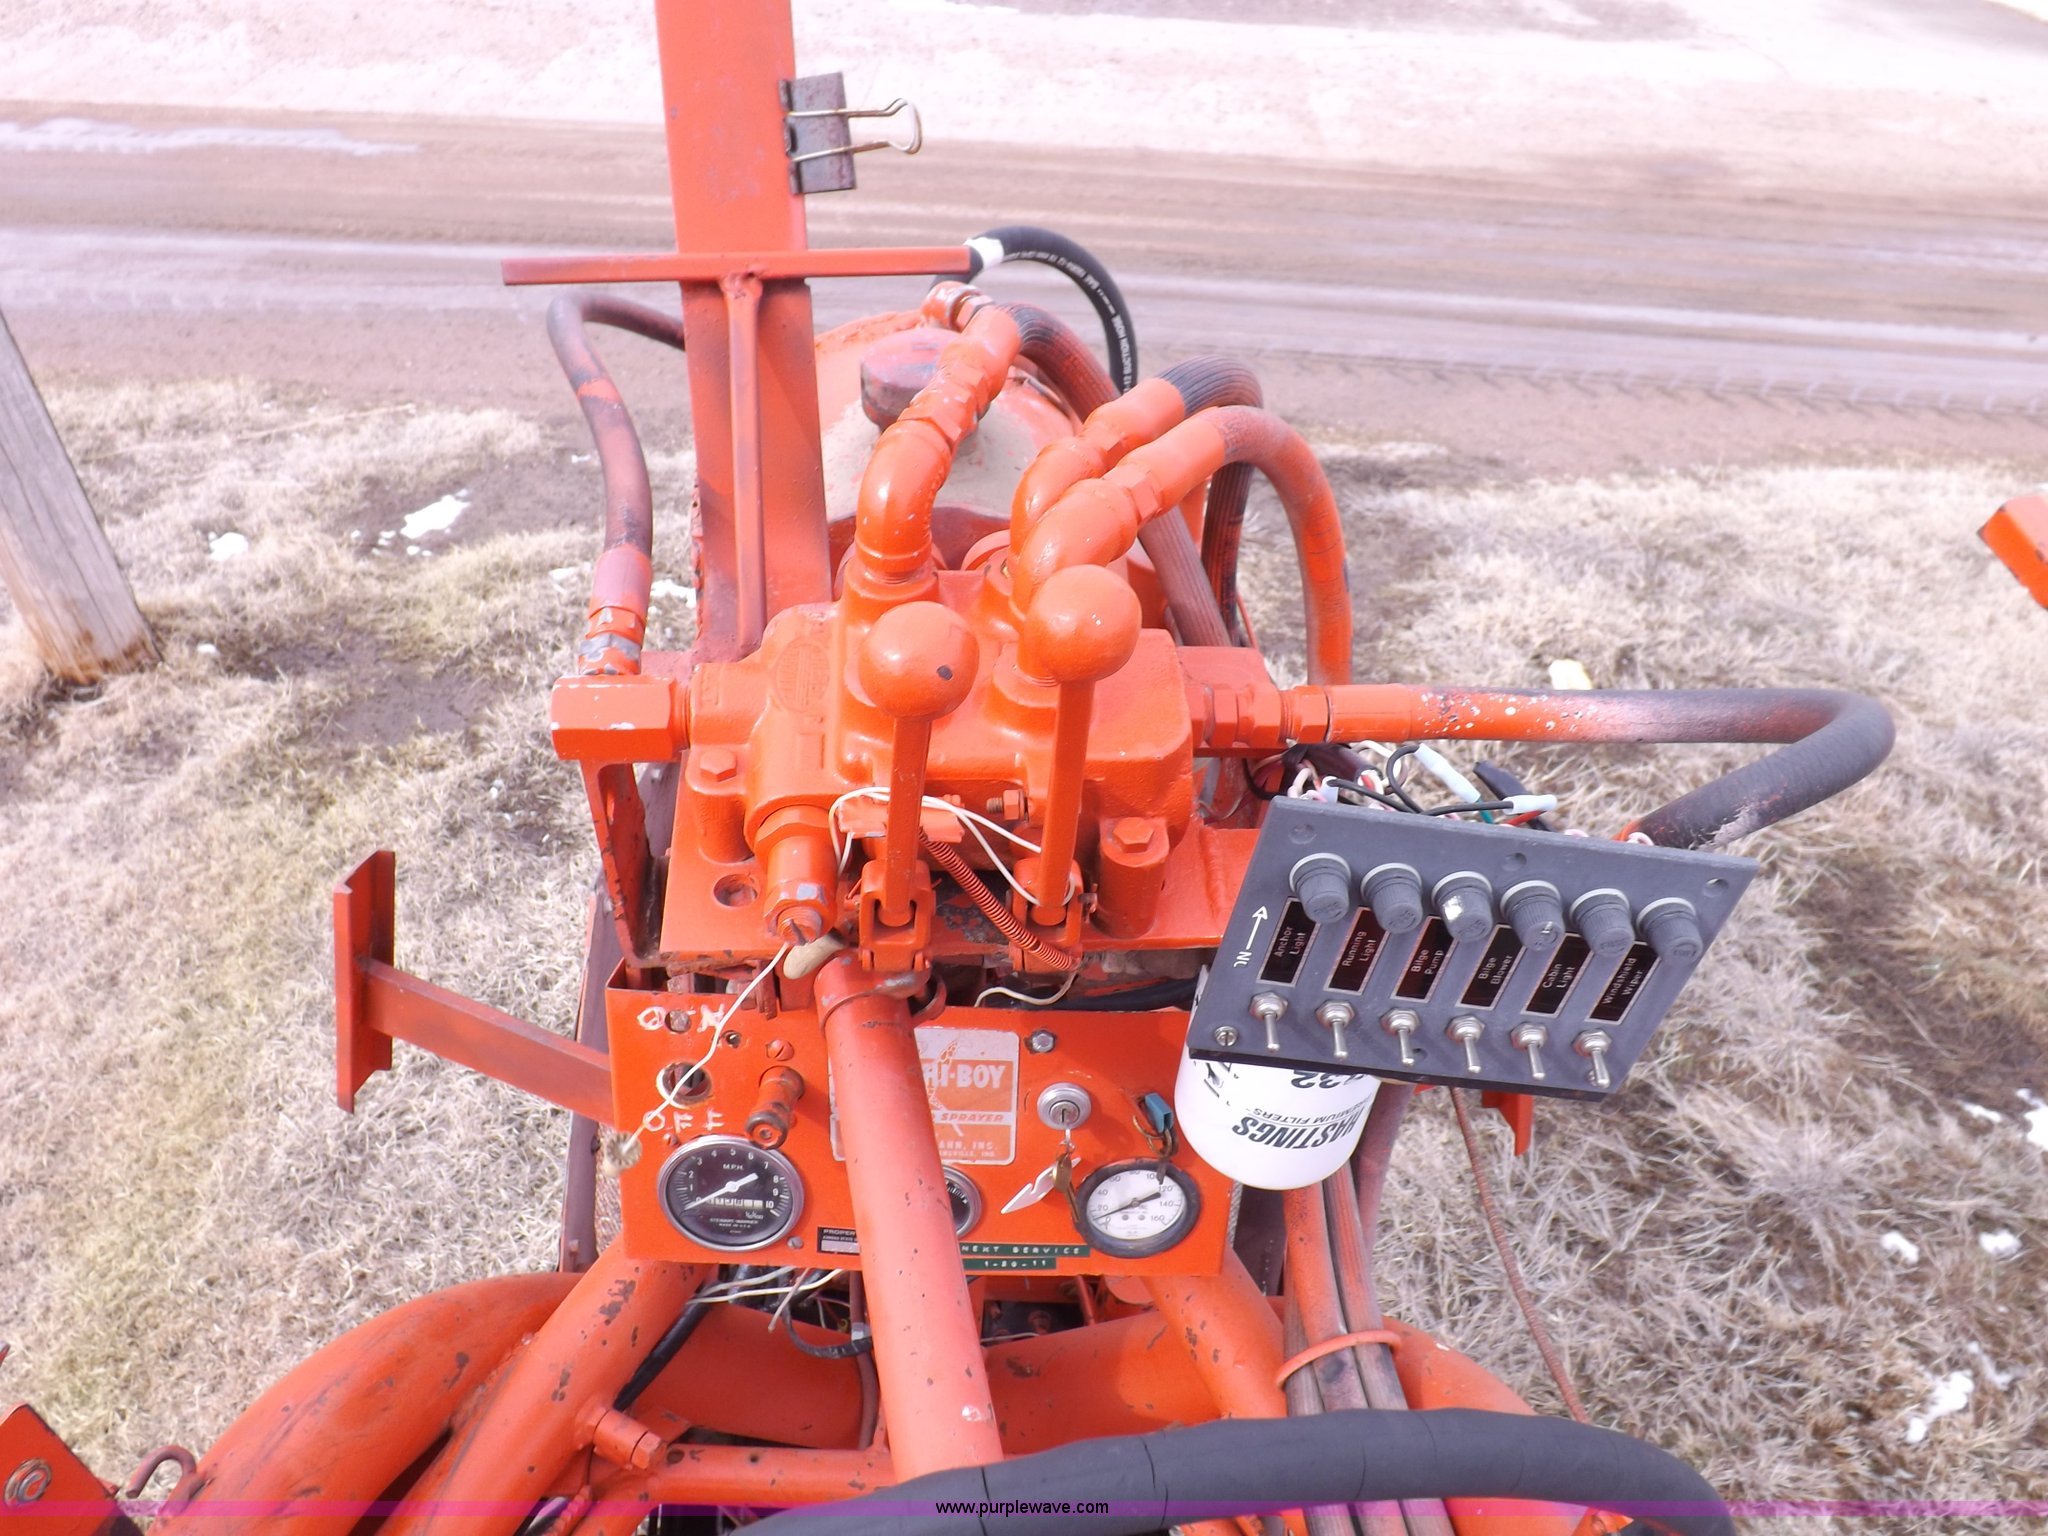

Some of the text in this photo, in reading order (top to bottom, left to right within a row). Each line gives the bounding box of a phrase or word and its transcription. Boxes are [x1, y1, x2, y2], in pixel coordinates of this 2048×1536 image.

[1274, 926, 1293, 957] Anchor
[1289, 932, 1306, 955] Light
[1342, 931, 1367, 967] Running
[1359, 939, 1377, 962] Light
[1411, 949, 1429, 973] Bilge
[1424, 950, 1444, 975] Pump
[1478, 957, 1497, 980] Bilge
[1490, 955, 1513, 985] Blower
[1542, 963, 1562, 988] Cabin
[1556, 966, 1576, 989] Light
[1603, 957, 1637, 1005] Windshield
[1621, 970, 1643, 995] Wiper
[941, 1112, 1005, 1122] SPRAYER
[1231, 1105, 1366, 1149] HASTINGS
[1253, 1108, 1311, 1125] FILTERS
[765, 1200, 775, 1209] 10
[961, 1245, 1080, 1254] NEXT SERVICE
